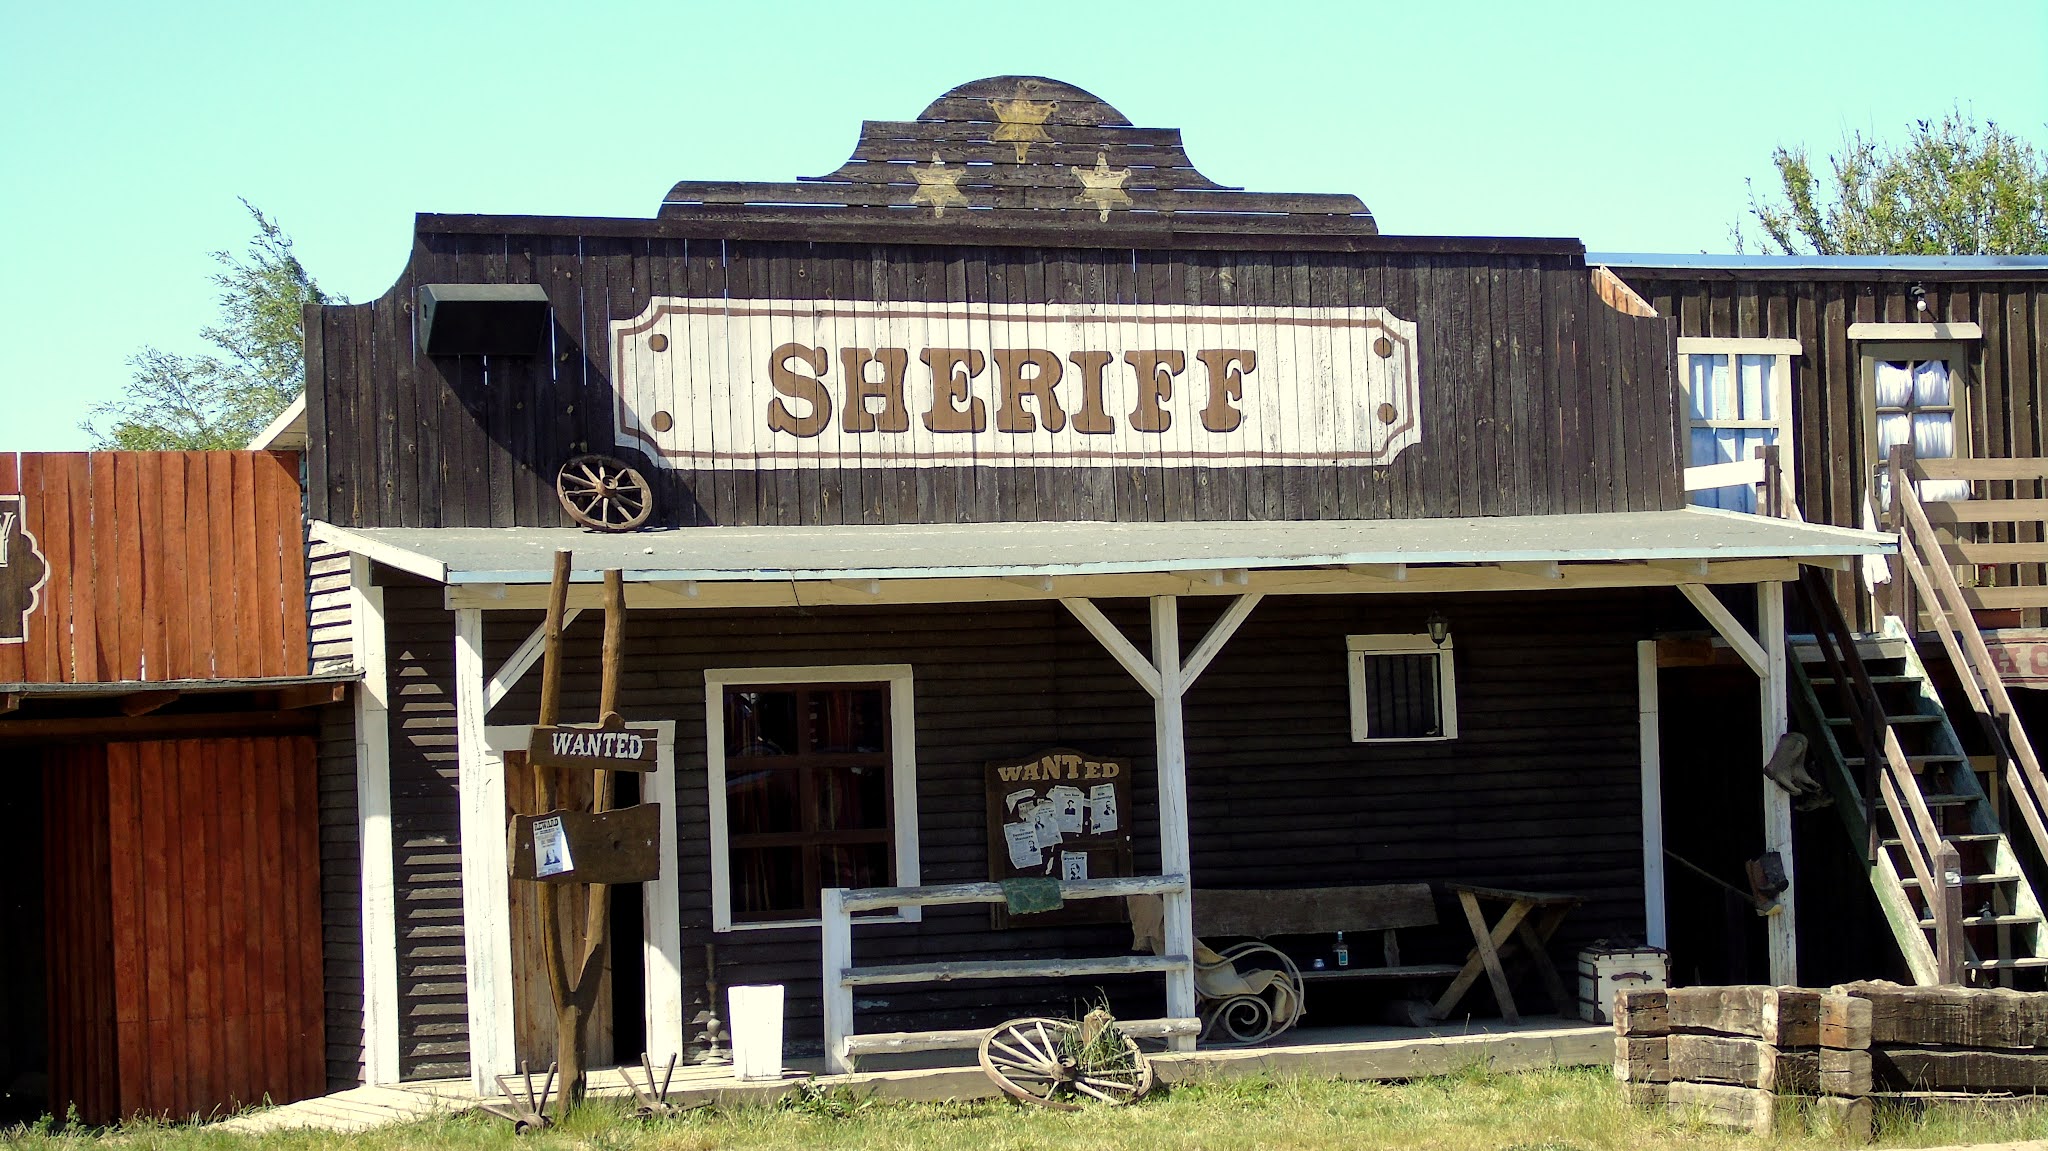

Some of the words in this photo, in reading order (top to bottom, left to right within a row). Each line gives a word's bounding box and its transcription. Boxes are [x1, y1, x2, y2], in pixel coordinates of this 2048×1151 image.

[767, 342, 1257, 438] SHERIFF
[552, 732, 643, 760] WANTED
[998, 755, 1120, 781] WANTED
